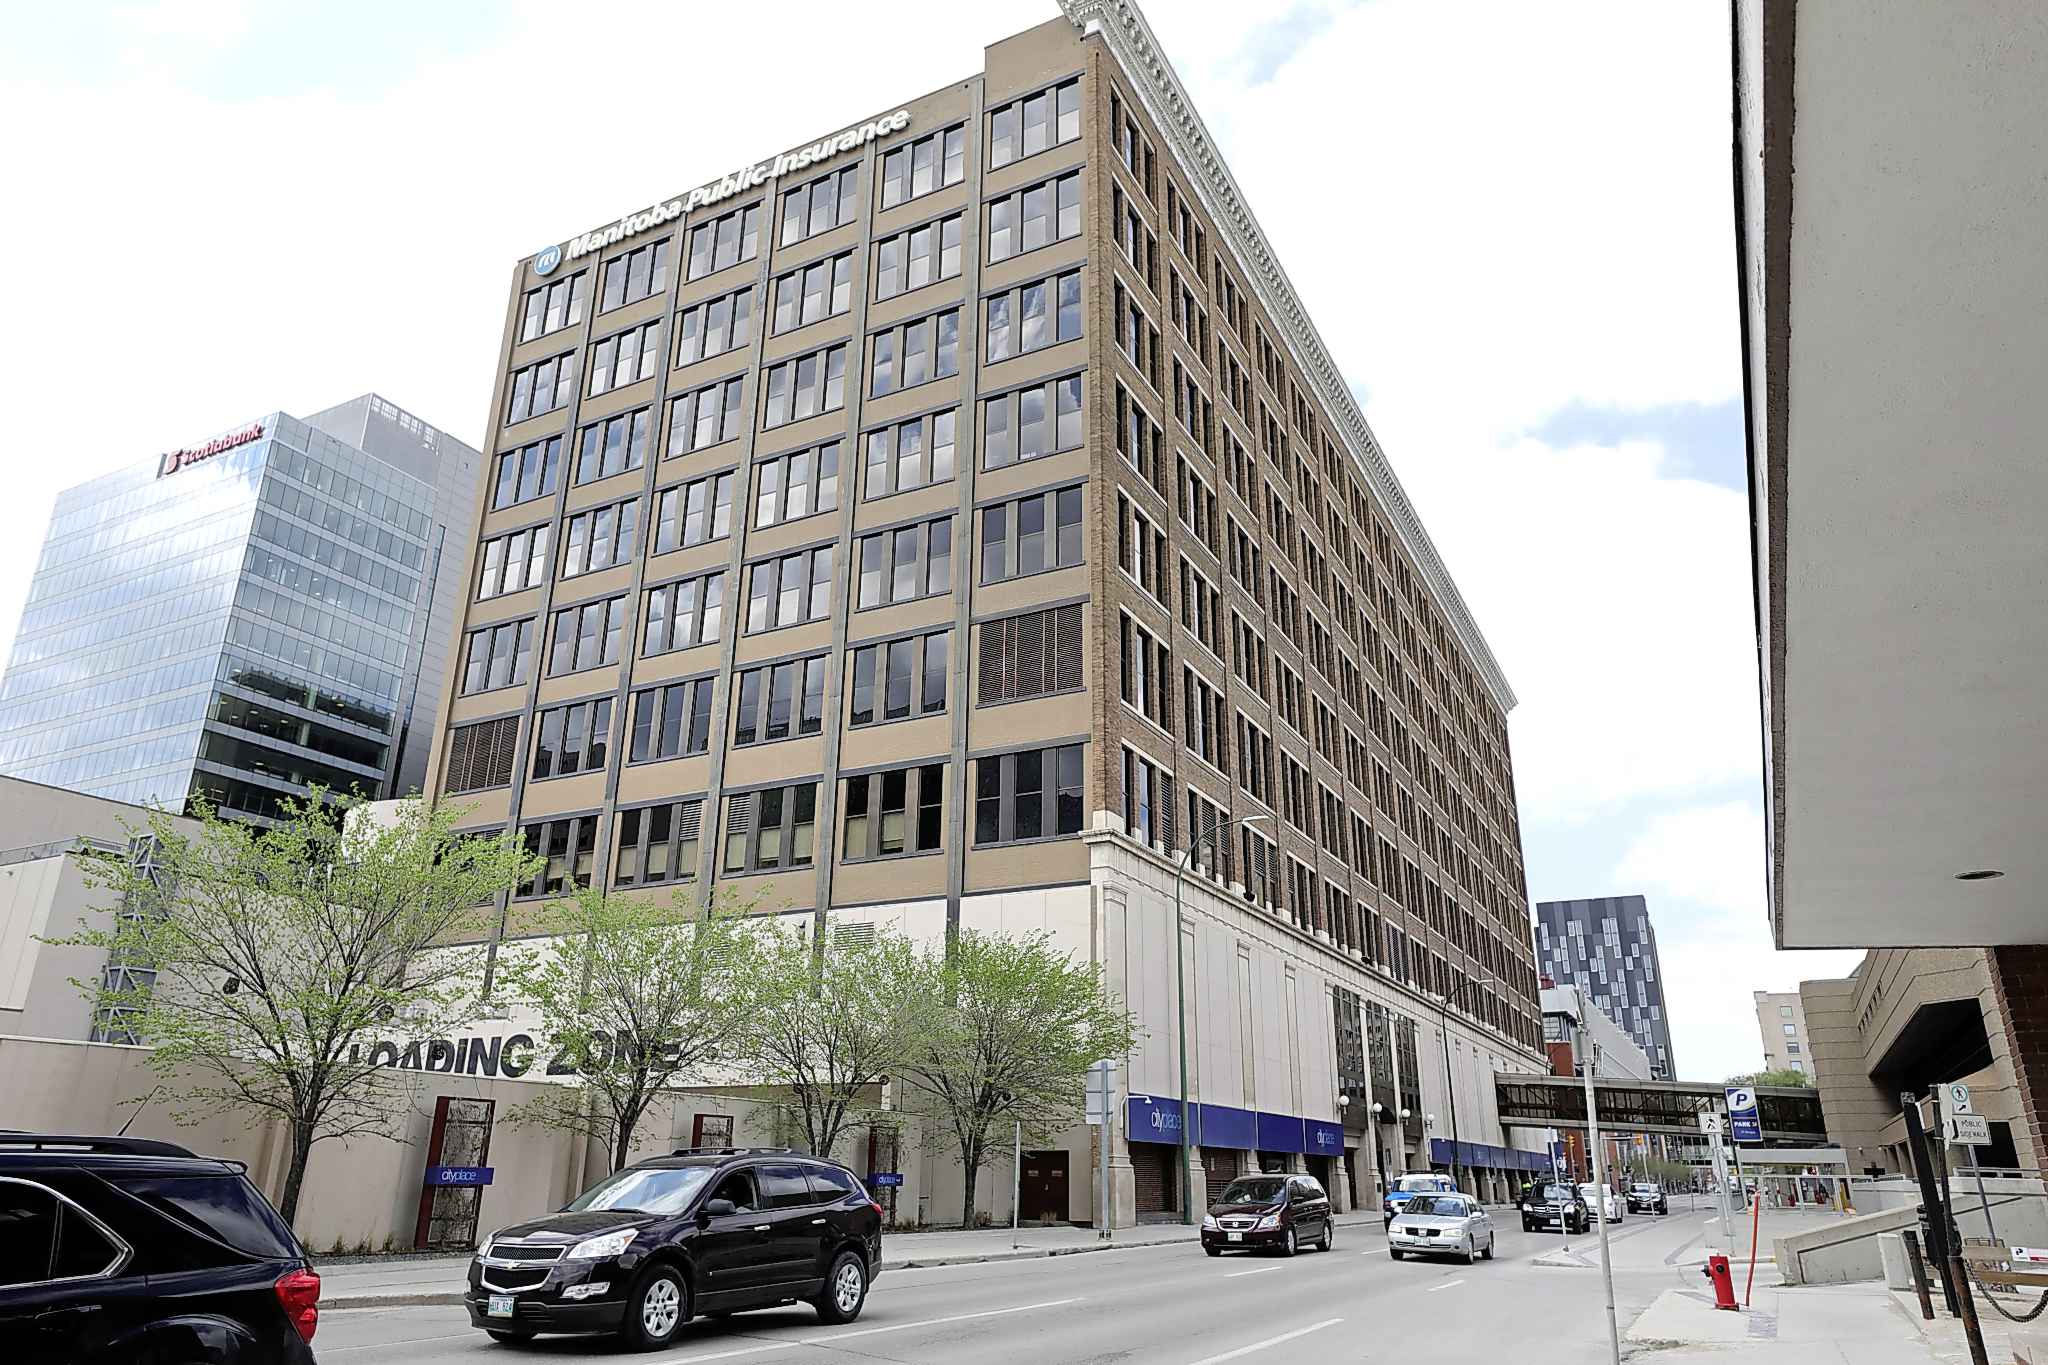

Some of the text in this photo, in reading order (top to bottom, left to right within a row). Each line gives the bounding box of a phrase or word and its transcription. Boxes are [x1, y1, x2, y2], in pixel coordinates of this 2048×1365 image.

[565, 108, 912, 262] Manitoba Public Insurance
[182, 422, 266, 466] Scotiabank
[1736, 1094, 1747, 1106] P
